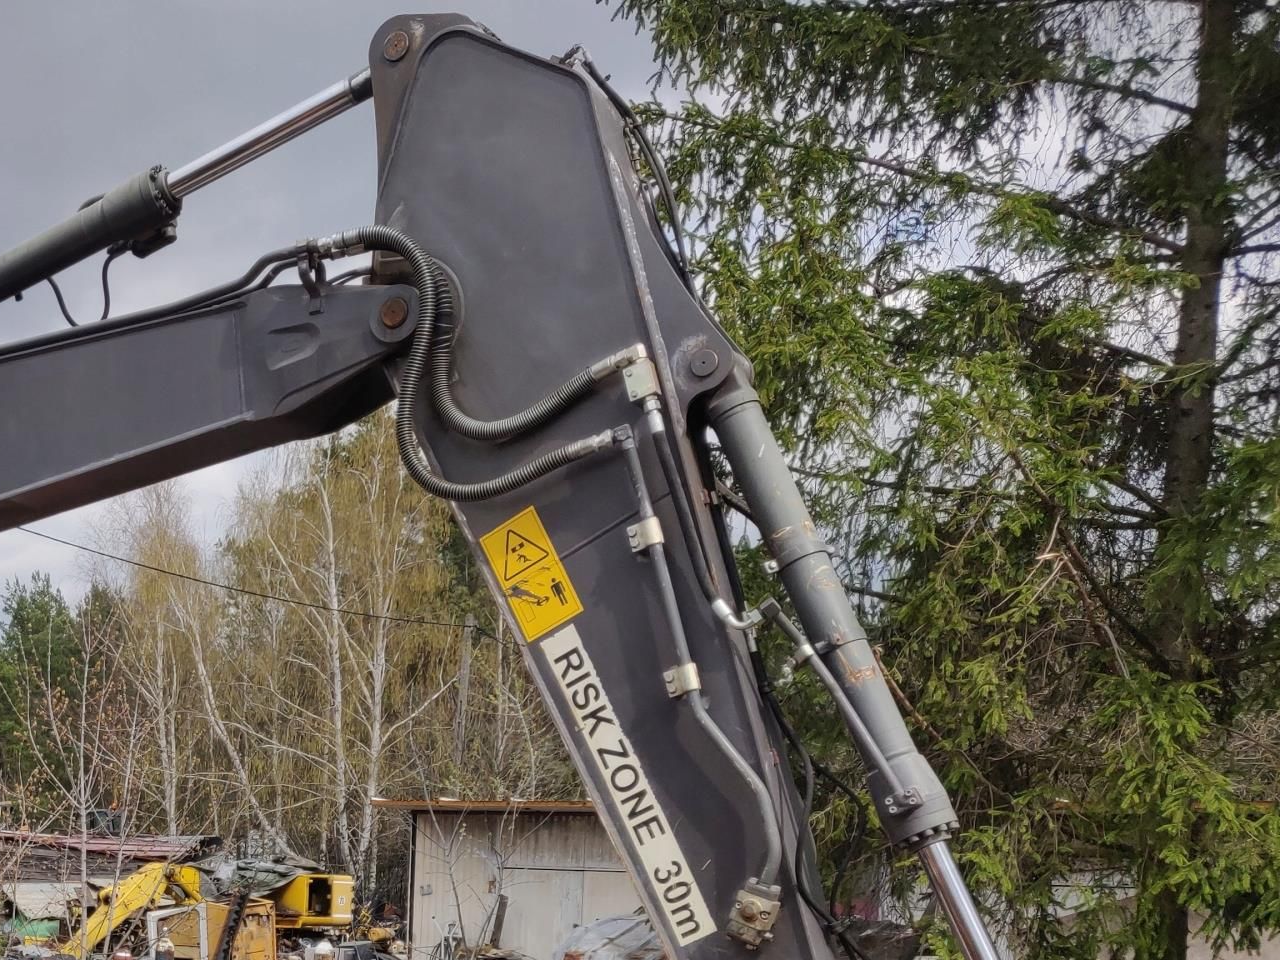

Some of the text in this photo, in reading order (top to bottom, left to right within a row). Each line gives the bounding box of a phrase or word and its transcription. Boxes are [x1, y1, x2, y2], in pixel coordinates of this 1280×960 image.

[554, 647, 701, 939] RISK ZONE 30m
